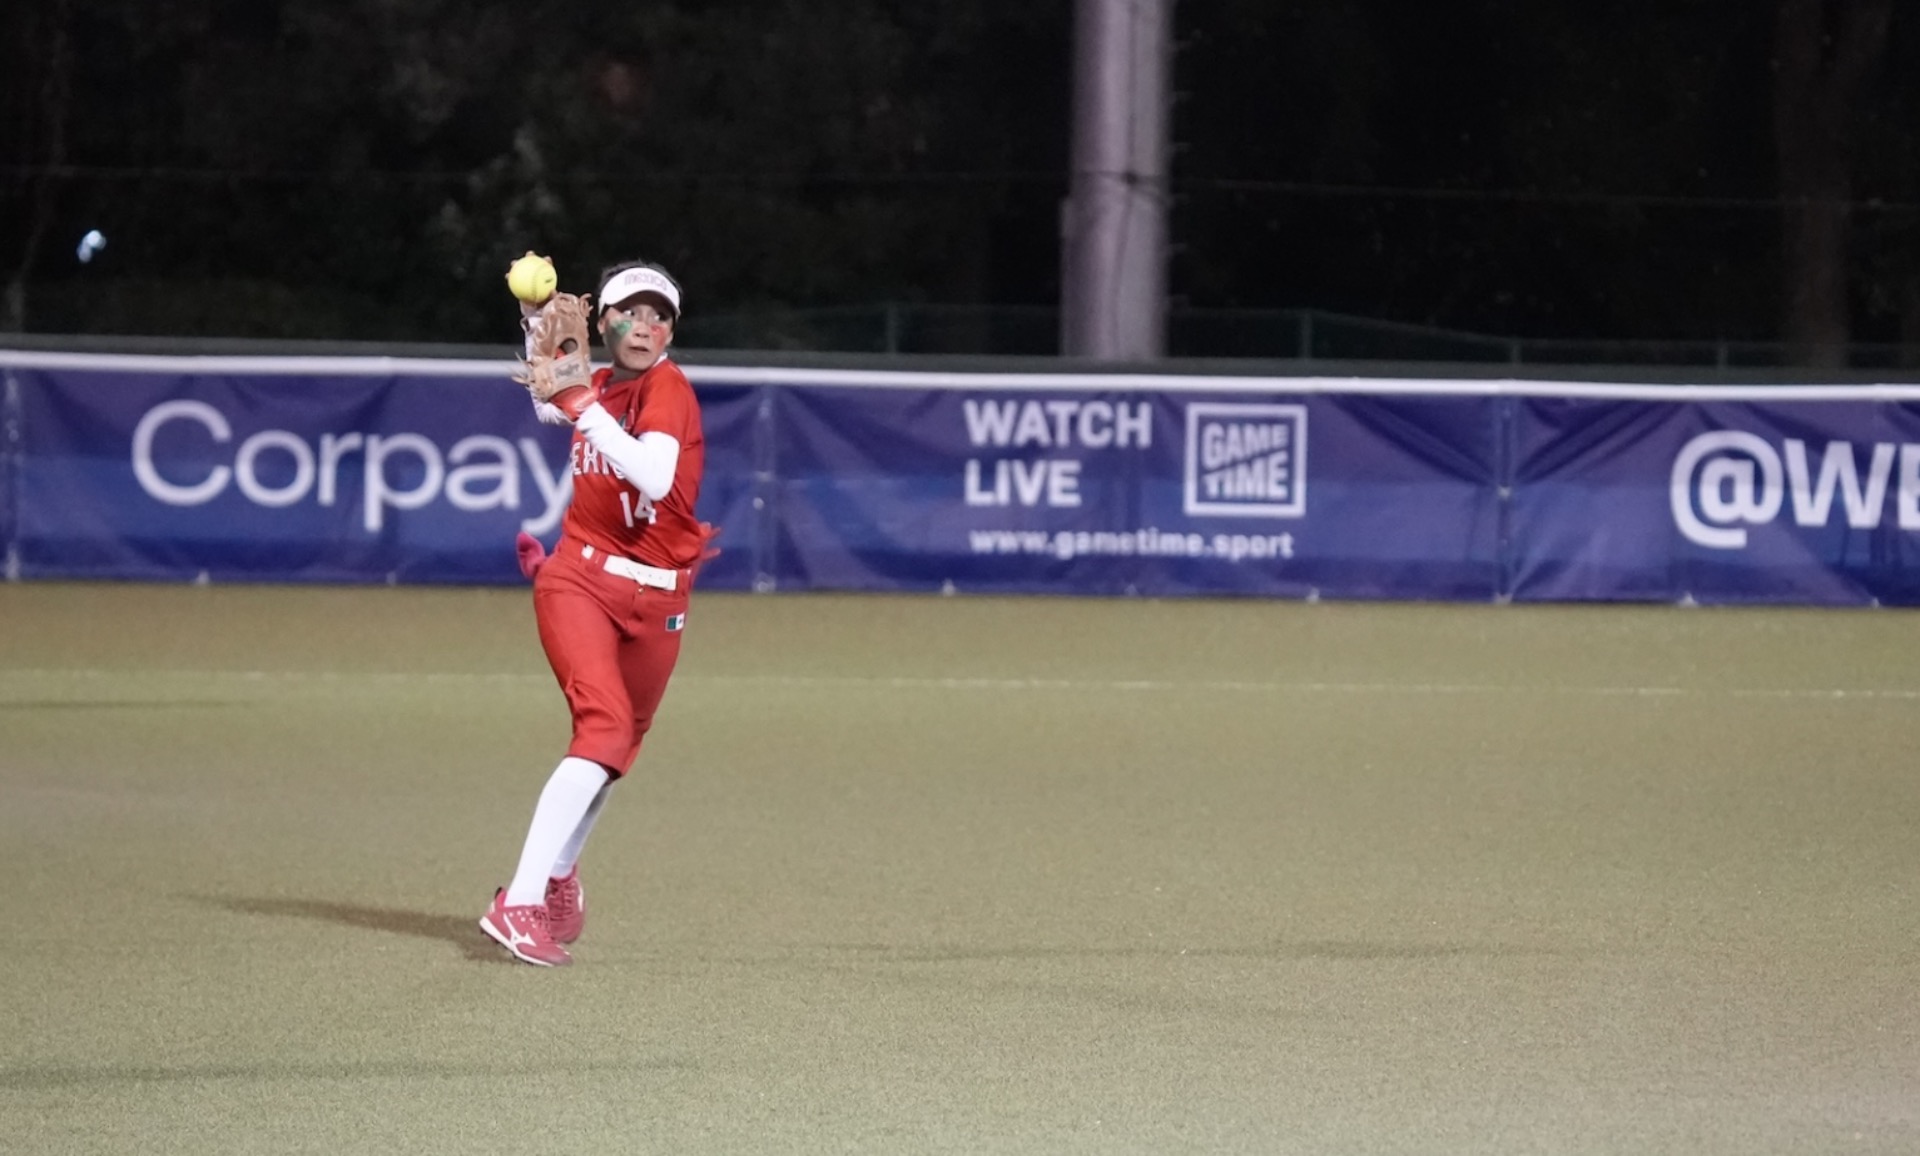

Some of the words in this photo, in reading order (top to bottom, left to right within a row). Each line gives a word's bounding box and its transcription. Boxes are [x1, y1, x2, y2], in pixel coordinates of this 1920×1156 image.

[964, 400, 1151, 447] WATCH
[1202, 422, 1289, 470] GAME
[131, 400, 573, 536] Corpay
[965, 459, 1081, 507] LIVE
[1203, 450, 1289, 499] TIME
[619, 491, 657, 528] 14
[969, 527, 1293, 560] www.gametime.sport
